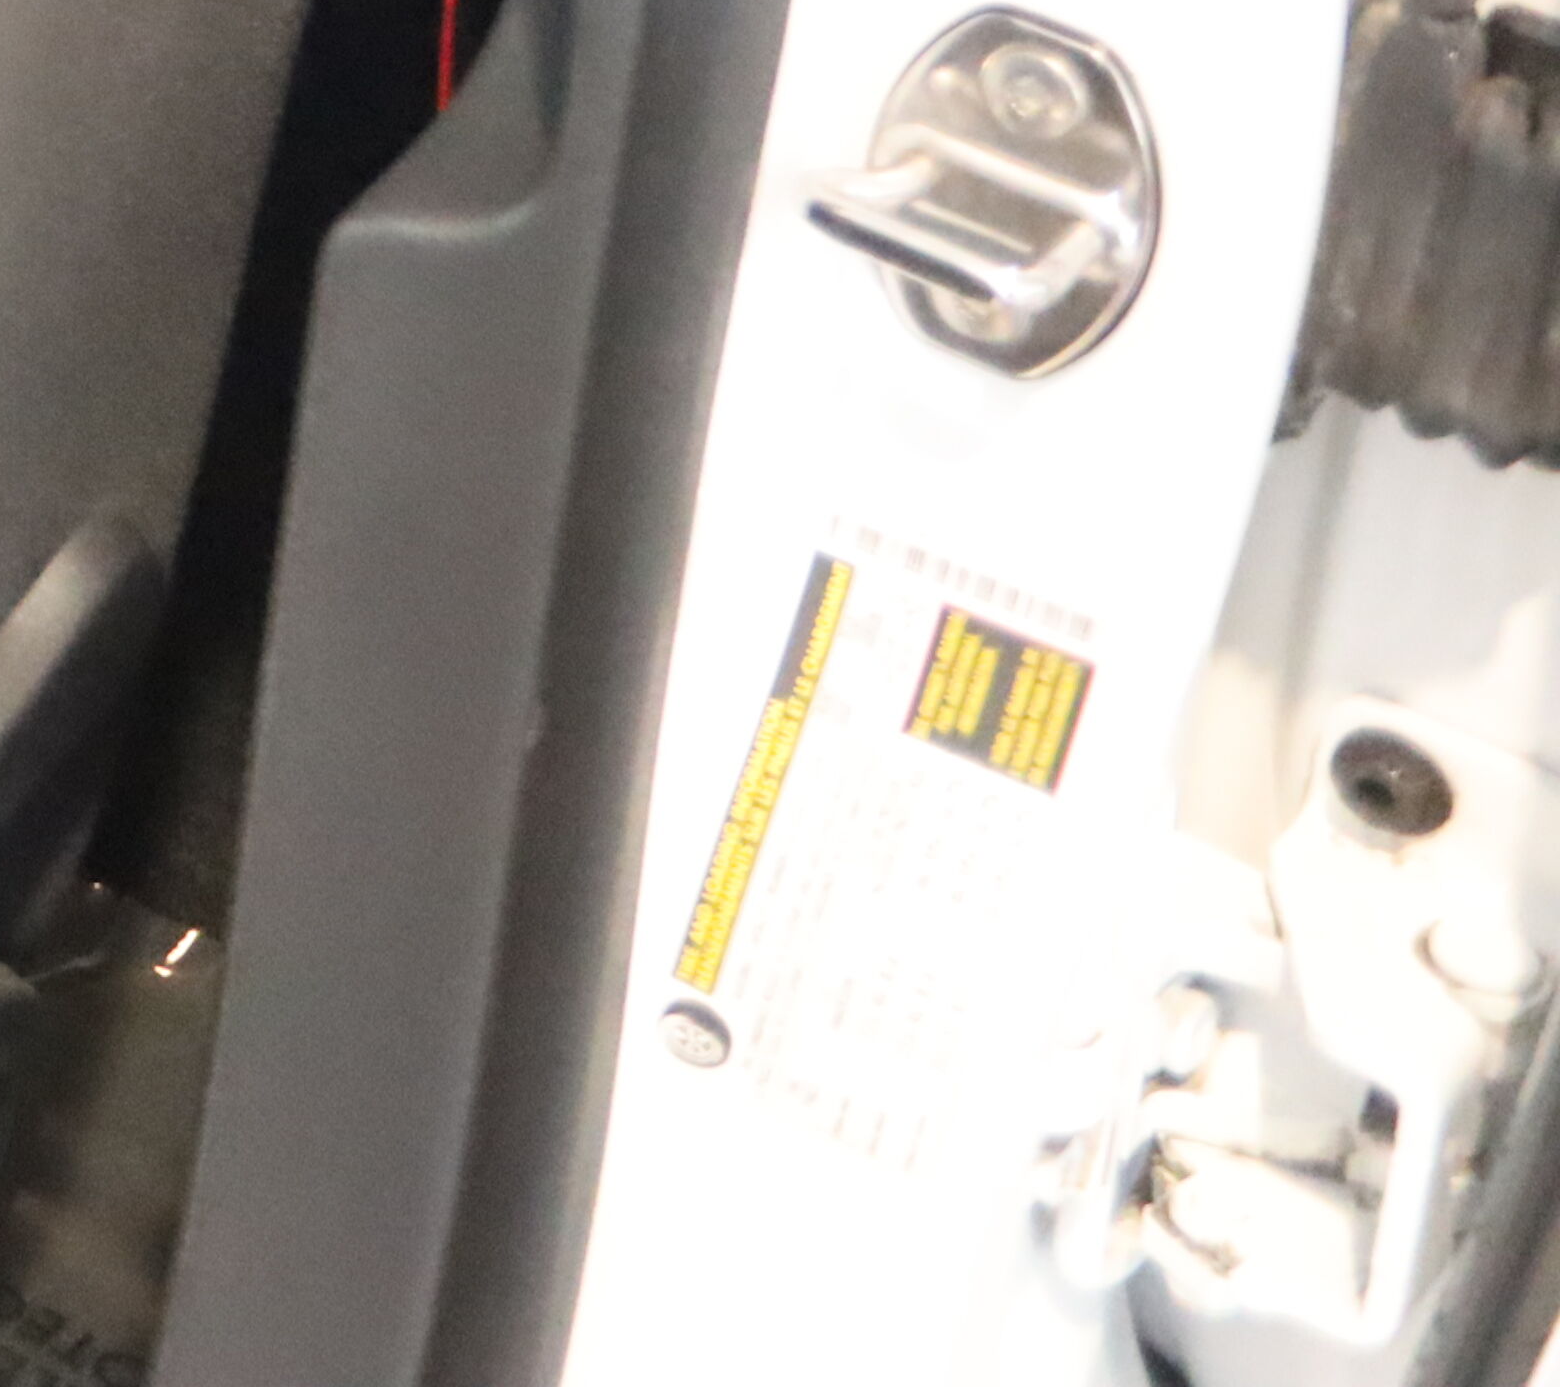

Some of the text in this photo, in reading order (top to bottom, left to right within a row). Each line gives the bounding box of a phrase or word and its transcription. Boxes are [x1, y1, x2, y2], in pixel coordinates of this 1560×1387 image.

[800, 559, 851, 676] CHARGEMENT
[688, 902, 714, 945] AND
[702, 820, 741, 902] LOADING
